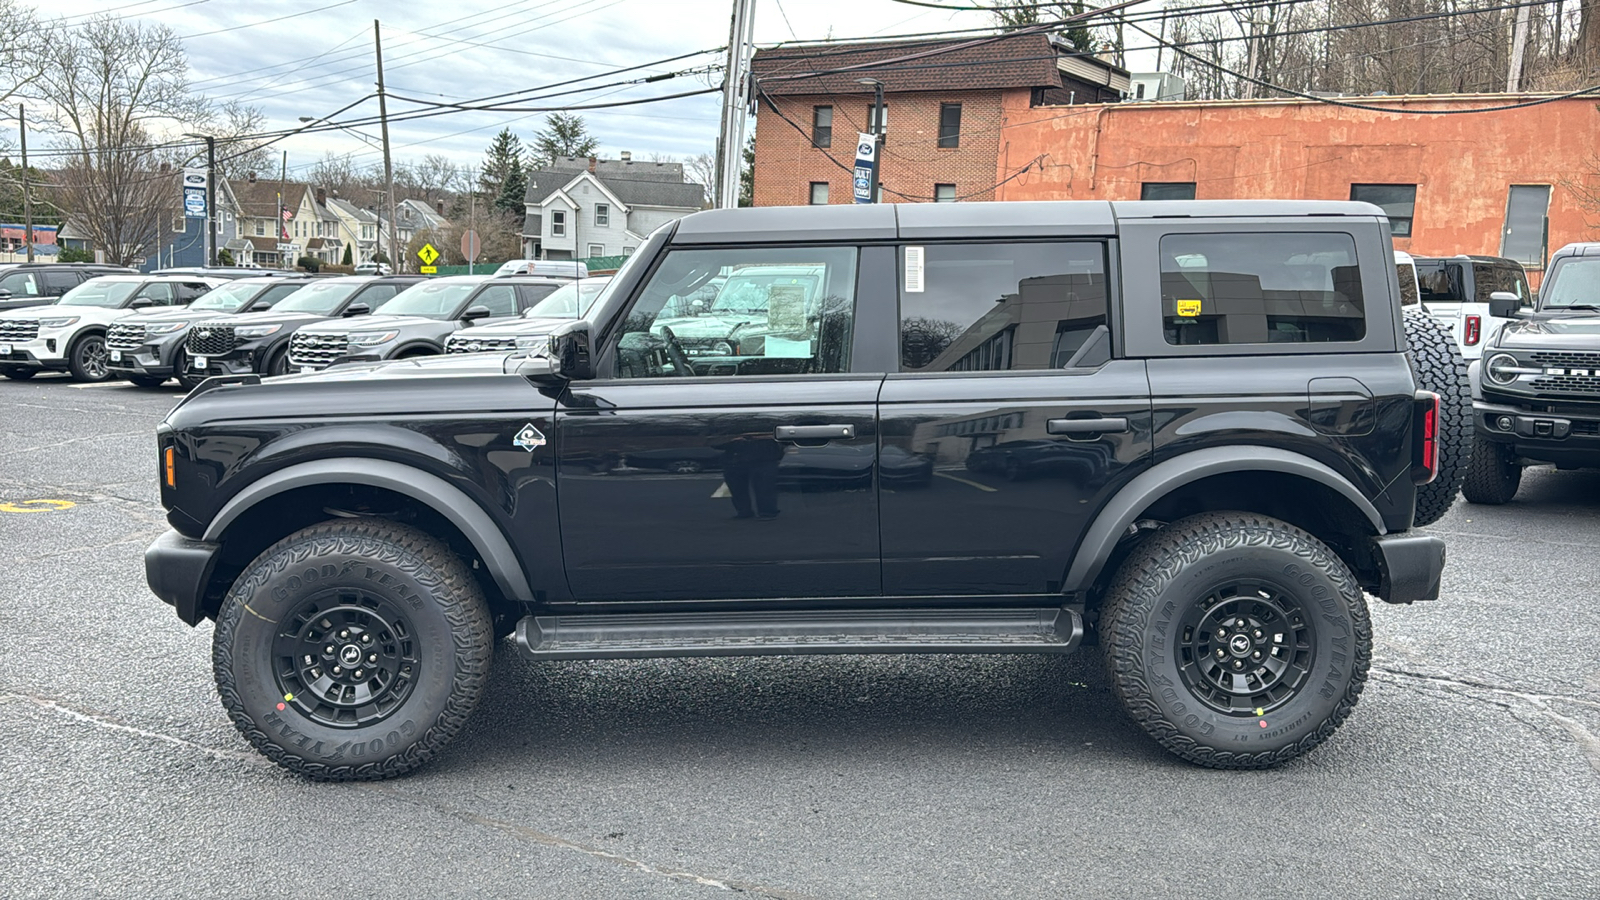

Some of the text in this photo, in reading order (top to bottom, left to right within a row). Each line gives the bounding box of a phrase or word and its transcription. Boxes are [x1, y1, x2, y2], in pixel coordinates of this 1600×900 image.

[188, 175, 204, 183] Ford
[856, 169, 870, 179] BUILT
[1259, 710, 1312, 740] TERRITORY
